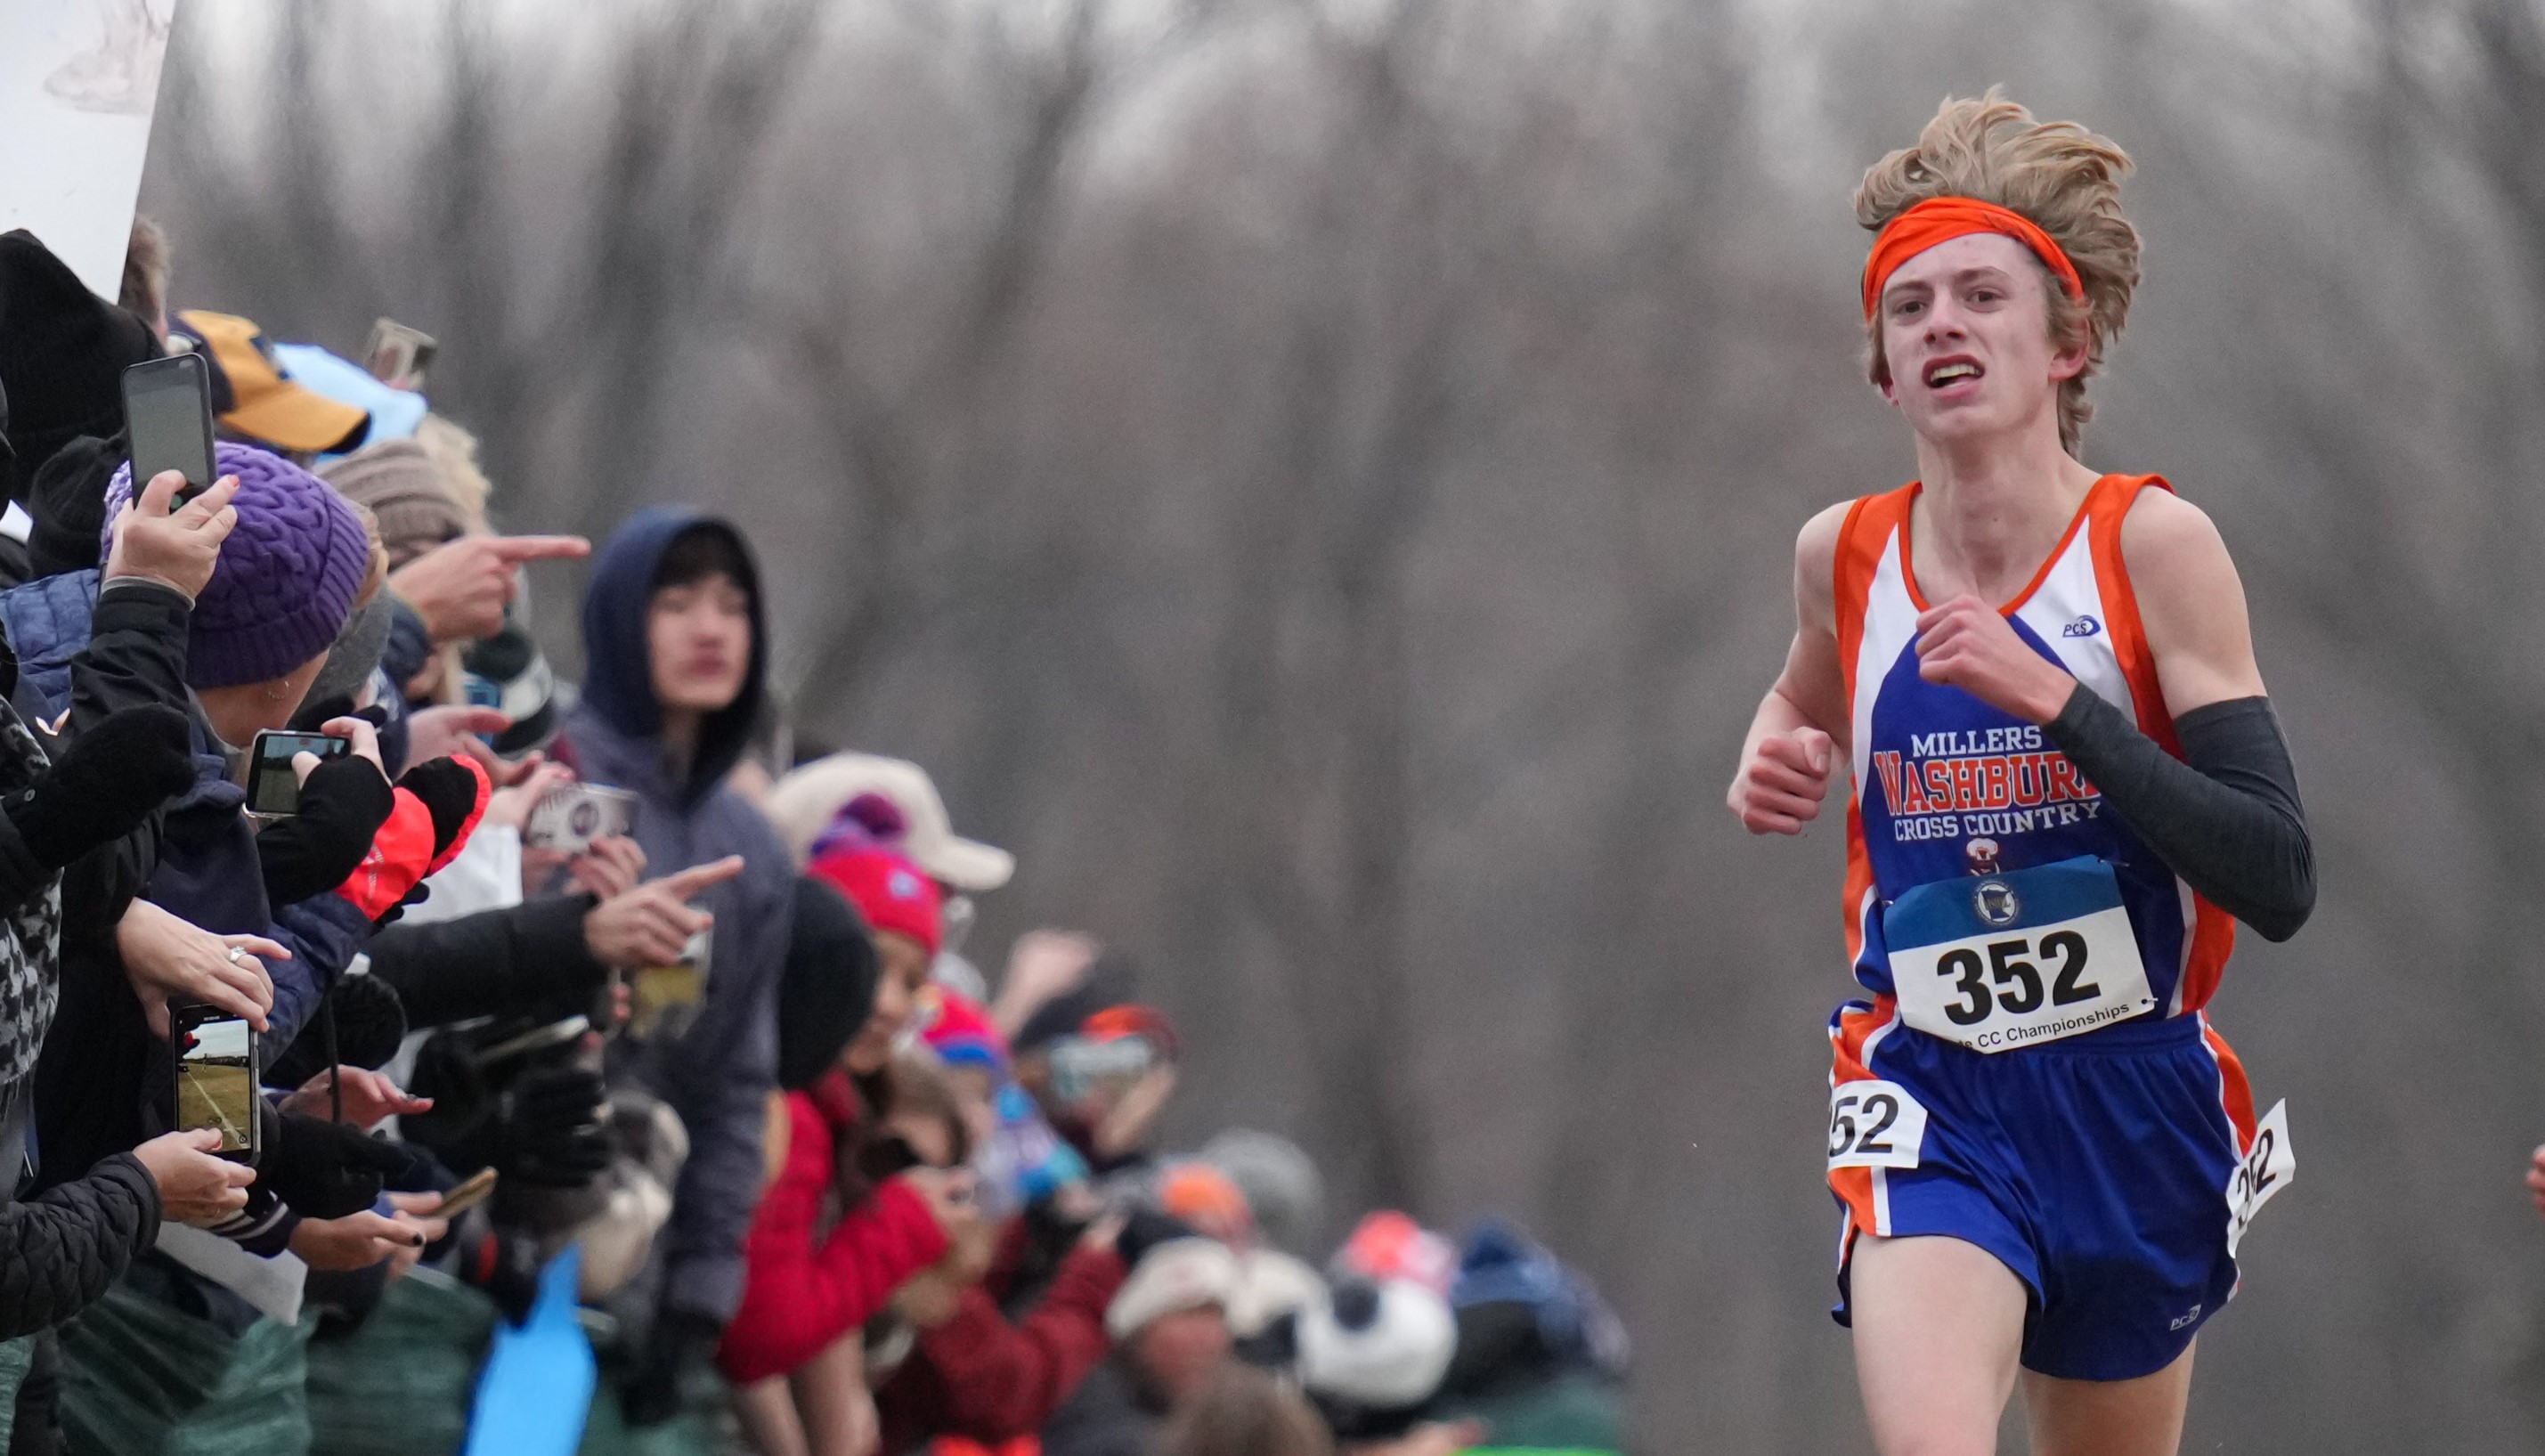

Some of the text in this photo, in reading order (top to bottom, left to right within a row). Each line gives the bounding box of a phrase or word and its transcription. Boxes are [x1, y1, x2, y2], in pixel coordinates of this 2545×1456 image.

[2062, 623, 2087, 637] PCS
[1911, 725, 2043, 758] MILLERS
[1894, 801, 2102, 842] CROSS COUNTRY
[1937, 930, 2102, 1026] 352
[1978, 1031, 2002, 1048] CC
[2006, 1003, 2131, 1042] Championships
[1829, 1094, 1899, 1158] 52
